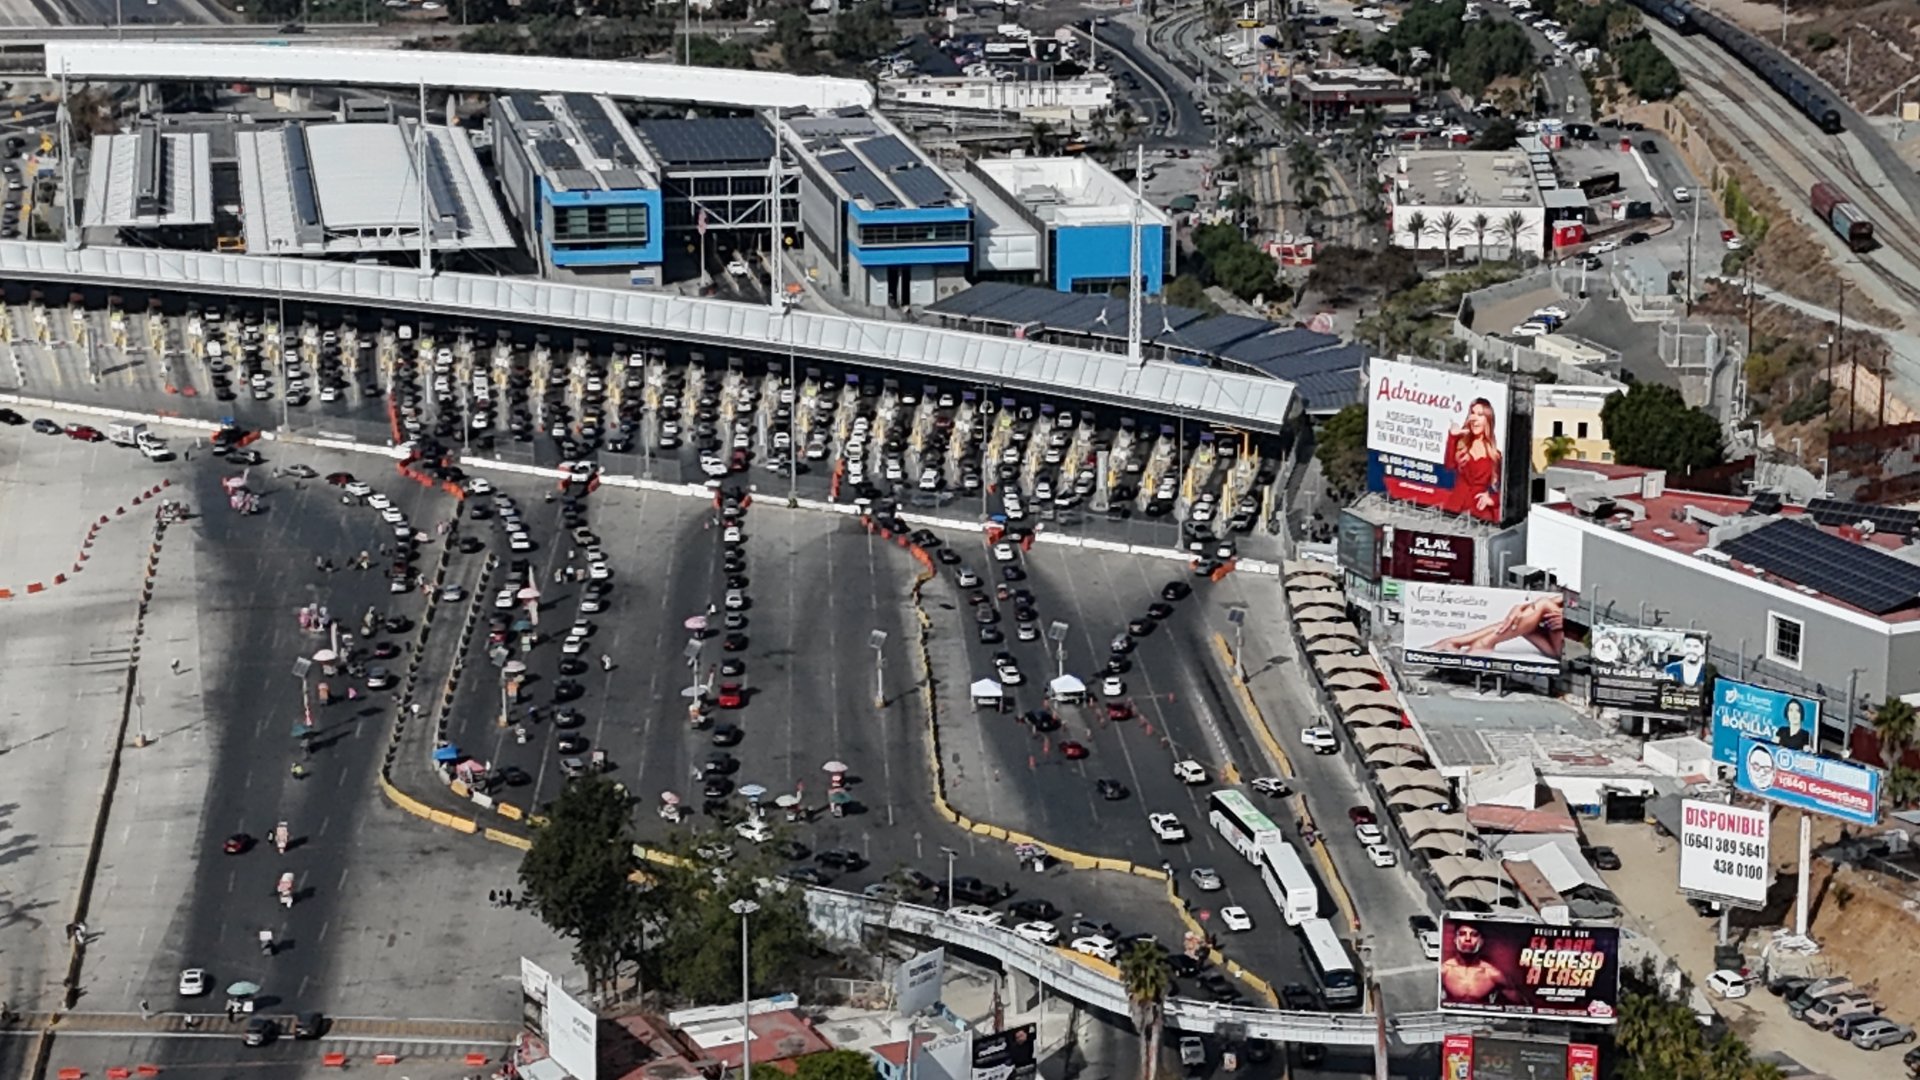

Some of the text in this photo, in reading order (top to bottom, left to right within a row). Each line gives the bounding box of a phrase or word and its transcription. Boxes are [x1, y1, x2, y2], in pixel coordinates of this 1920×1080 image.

[1377, 377, 1463, 413] Adriana's
[1376, 420, 1395, 431] AUTO
[1423, 418, 1433, 429] TU
[1377, 431, 1387, 441] EN
[1415, 537, 1451, 551] PLAY.
[1598, 667, 1611, 675] TU
[1612, 668, 1638, 677] CASA
[1686, 807, 1765, 838] DISPONIBLE
[1684, 832, 1765, 859] (664) 389 5641
[1713, 859, 1763, 880] 438 0100
[1530, 936, 1547, 951] EL
[1519, 948, 1605, 970] REGRESO
[1526, 966, 1596, 987] A CASA
